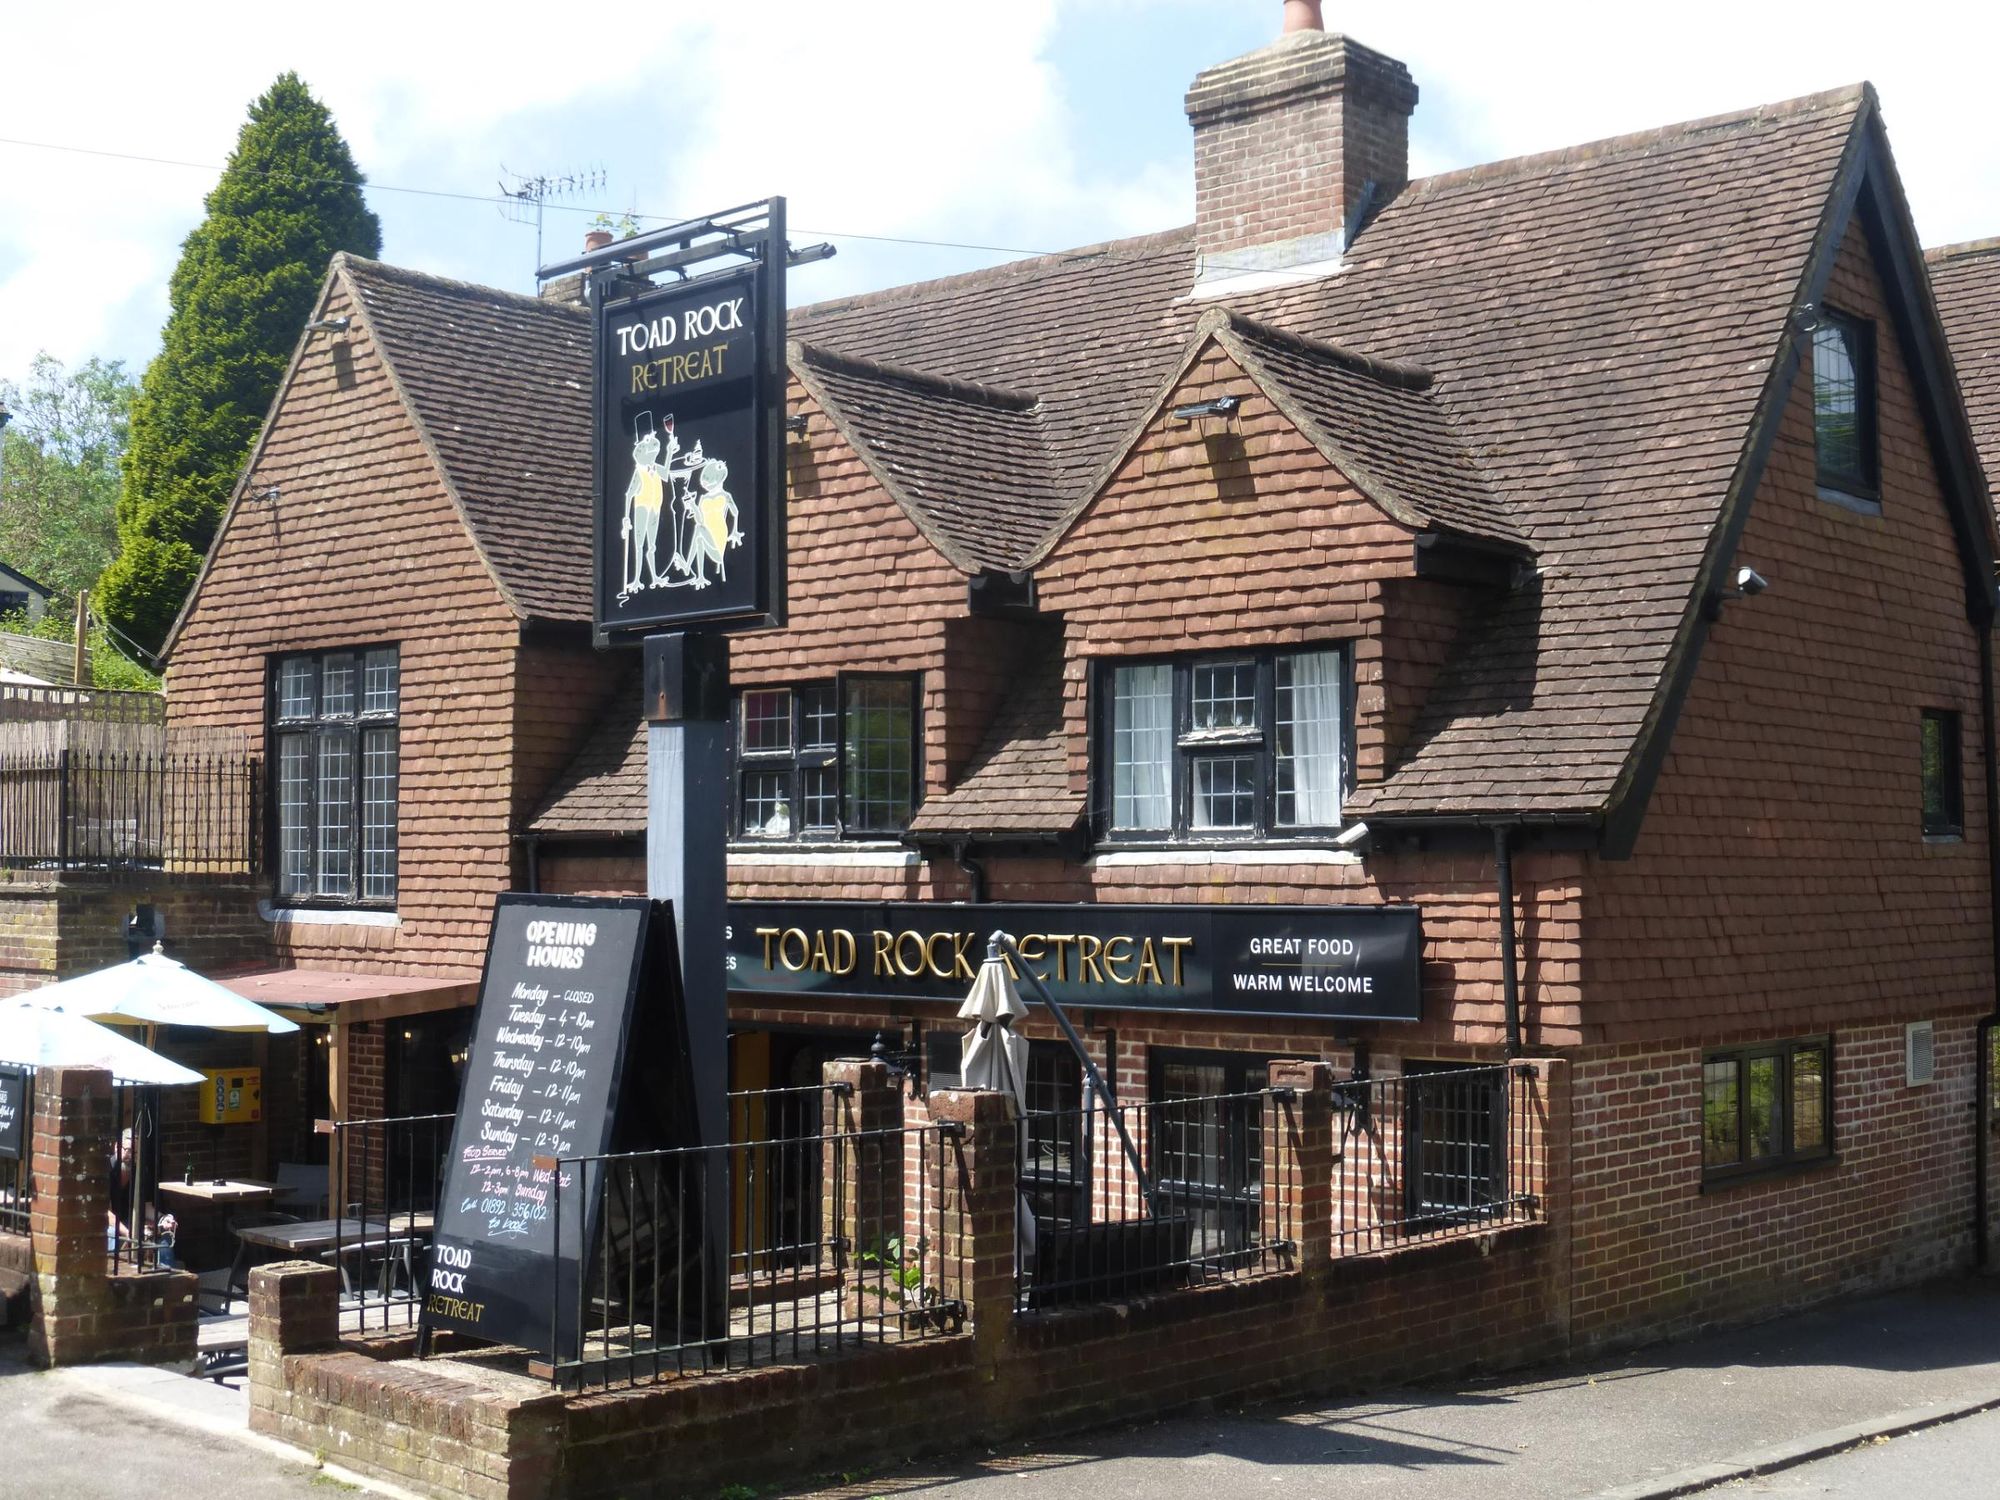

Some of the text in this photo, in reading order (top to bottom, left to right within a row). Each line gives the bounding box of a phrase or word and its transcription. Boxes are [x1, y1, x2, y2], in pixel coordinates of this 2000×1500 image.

[617, 297, 744, 356] TOAD ROCK
[631, 343, 729, 394] RETREAT
[526, 920, 598, 947] OPENING
[526, 946, 585, 969] HOURS
[756, 927, 857, 975] TOAD
[873, 930, 977, 979] ROCK
[1250, 938, 1354, 956] GREAT FOOD
[511, 982, 549, 1006] Monday
[563, 989, 595, 1004] CLOSED
[1233, 973, 1373, 993] WARM WELCOME
[508, 1004, 546, 1029] Tuesday
[496, 1026, 544, 1052] Wednesday
[492, 1051, 535, 1078] Thursday
[489, 1075, 524, 1101] Friday
[481, 1099, 525, 1126] Saturday
[480, 1121, 518, 1151] Sunday
[480, 1198, 506, 1214] 01892
[515, 1183, 548, 1207] Sunday
[437, 1244, 472, 1269] TOAD
[431, 1268, 467, 1294] ROCK
[427, 1294, 485, 1322] RETREAT
